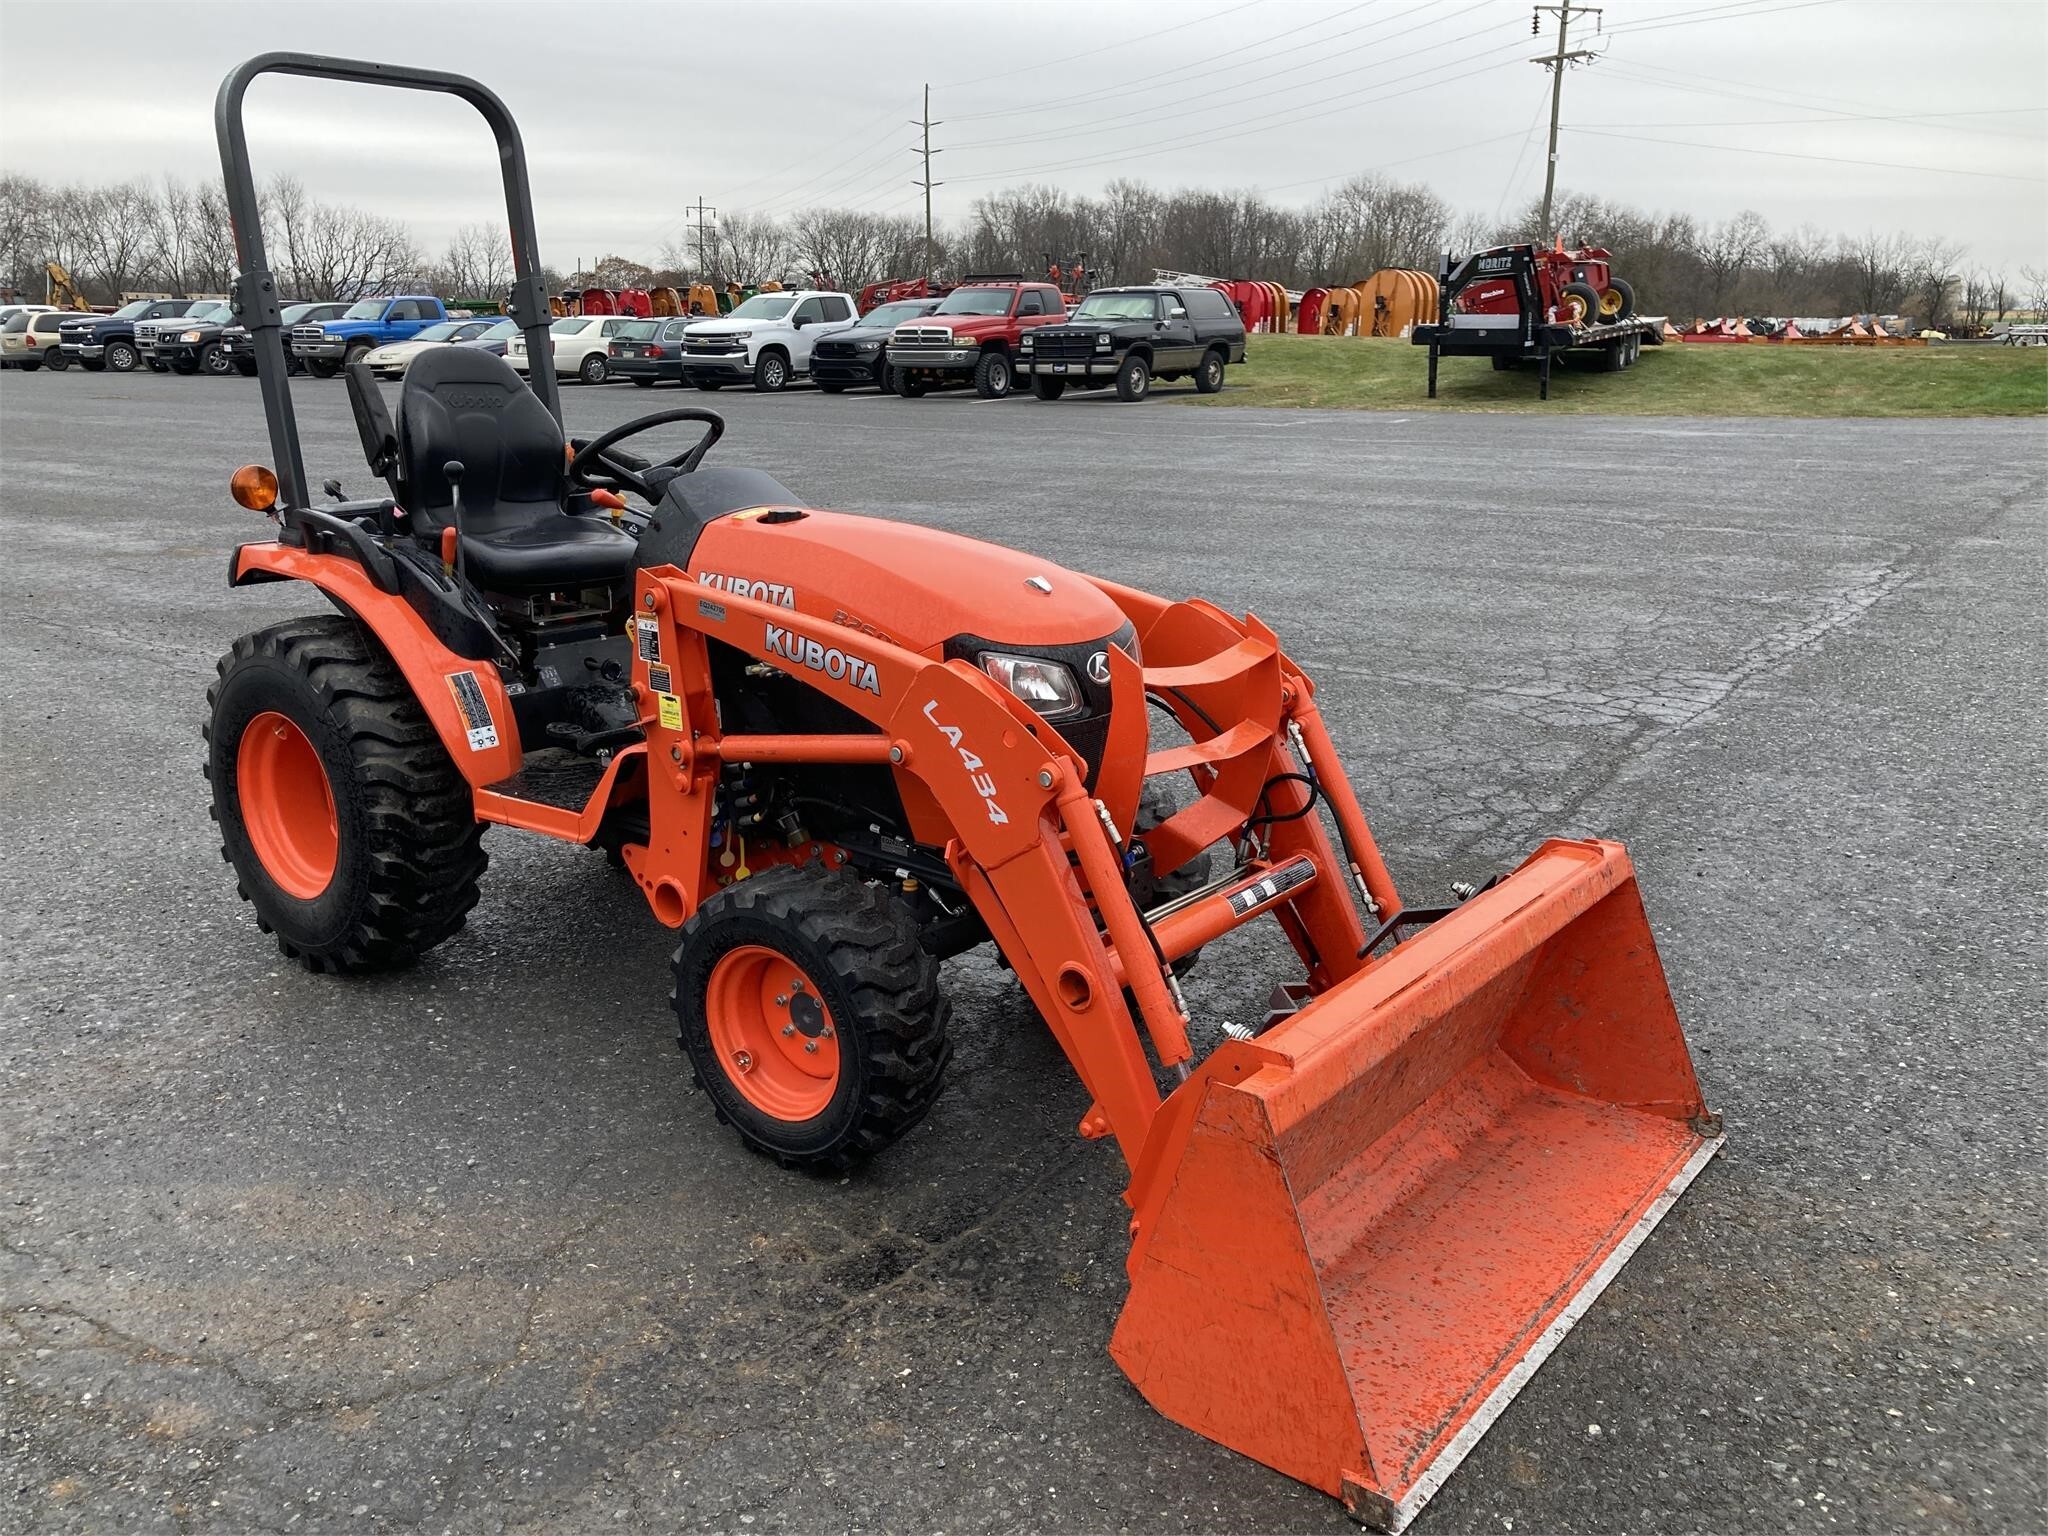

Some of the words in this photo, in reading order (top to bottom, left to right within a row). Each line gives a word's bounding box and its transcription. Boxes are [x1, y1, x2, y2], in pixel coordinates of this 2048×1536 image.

[1478, 256, 1512, 270] MORITZ
[698, 572, 796, 611] KUBOTA
[765, 623, 882, 697] KUBOTA
[922, 699, 1009, 825] LA434
